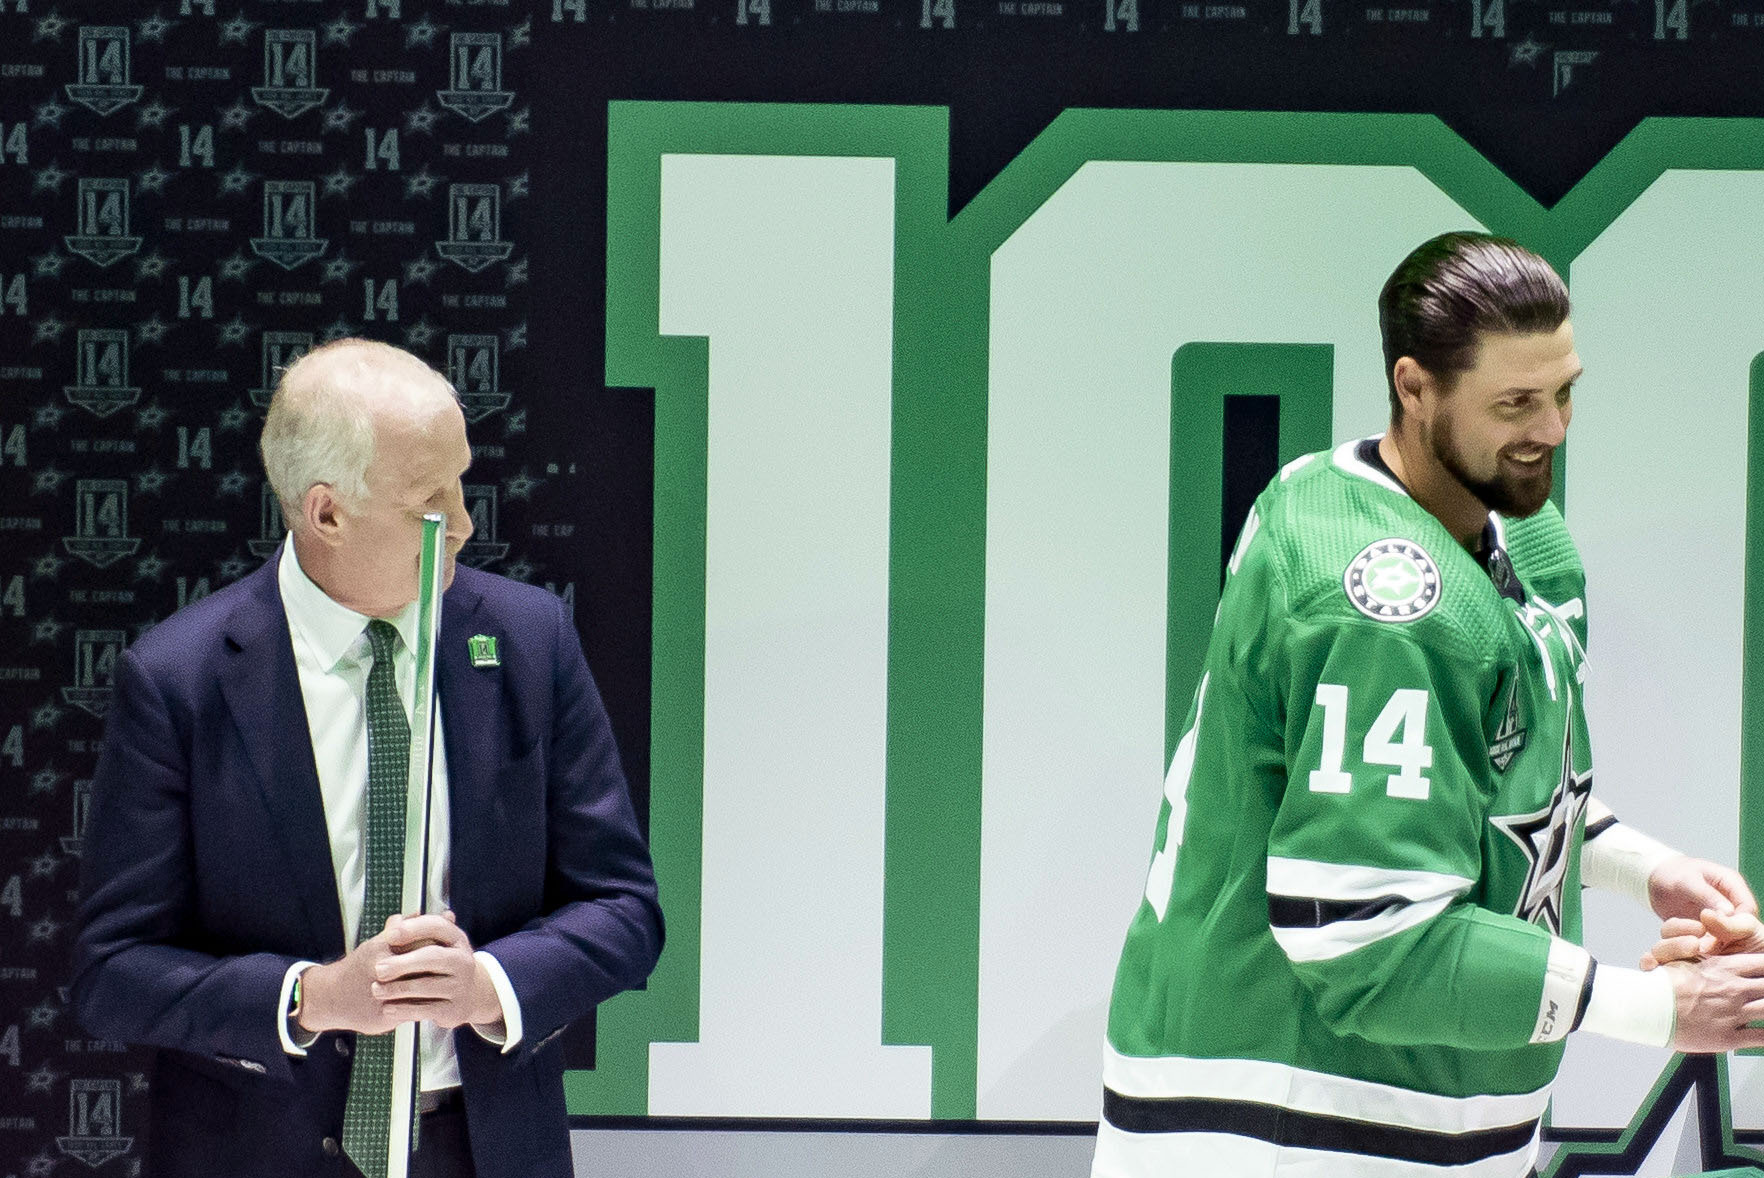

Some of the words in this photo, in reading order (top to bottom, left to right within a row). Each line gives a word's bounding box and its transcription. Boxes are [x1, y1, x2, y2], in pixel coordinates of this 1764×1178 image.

[86, 40, 120, 81] 14
[458, 47, 492, 88] 14
[179, 125, 214, 167] 14
[365, 129, 400, 171] 14
[178, 277, 213, 319] 14
[364, 279, 399, 321] 14
[177, 427, 212, 469] 14
[84, 493, 118, 534] 14
[1308, 682, 1433, 801] 14
[77, 1093, 111, 1134] 14
